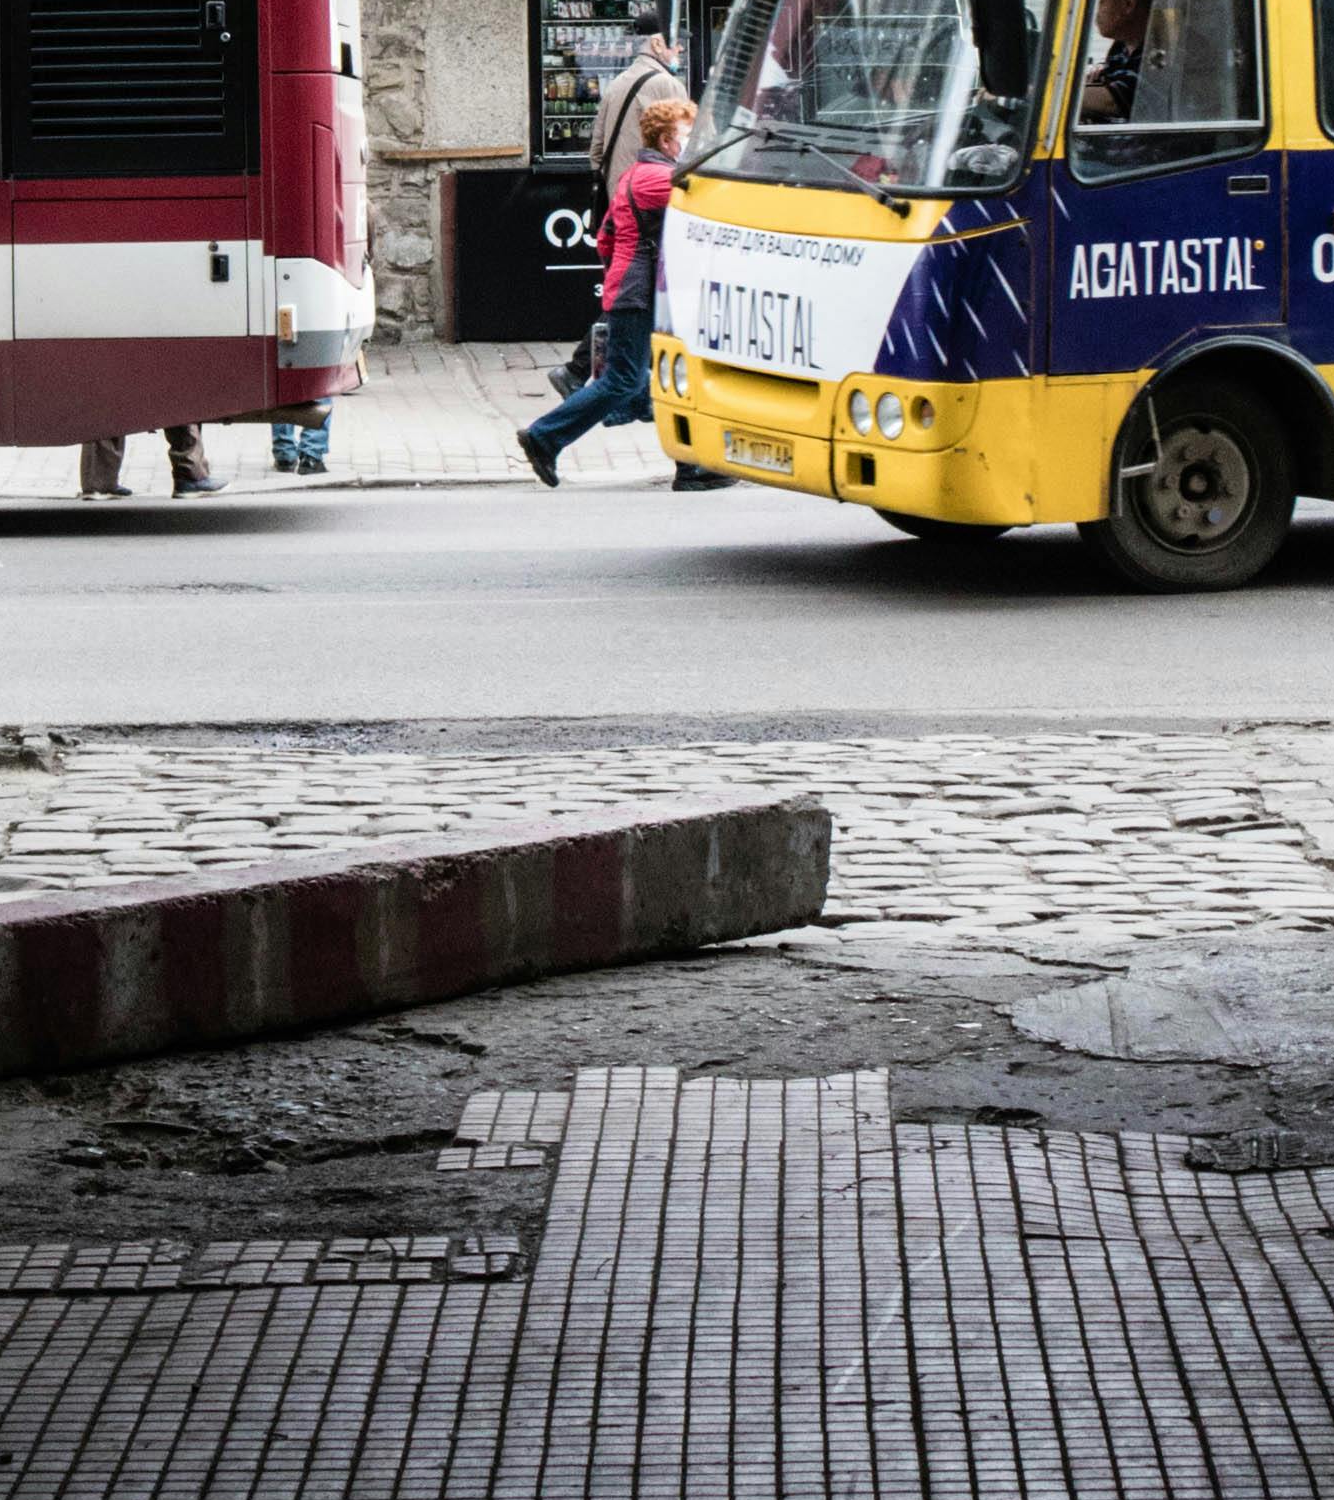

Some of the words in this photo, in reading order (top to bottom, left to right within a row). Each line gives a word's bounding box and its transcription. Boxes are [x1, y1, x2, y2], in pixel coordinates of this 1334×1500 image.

[766, 234, 819, 260] ВАШОГО
[820, 241, 866, 270] ДОМУ
[1069, 236, 1266, 299] AGATASTAL
[697, 278, 824, 371] AGATASTAL
